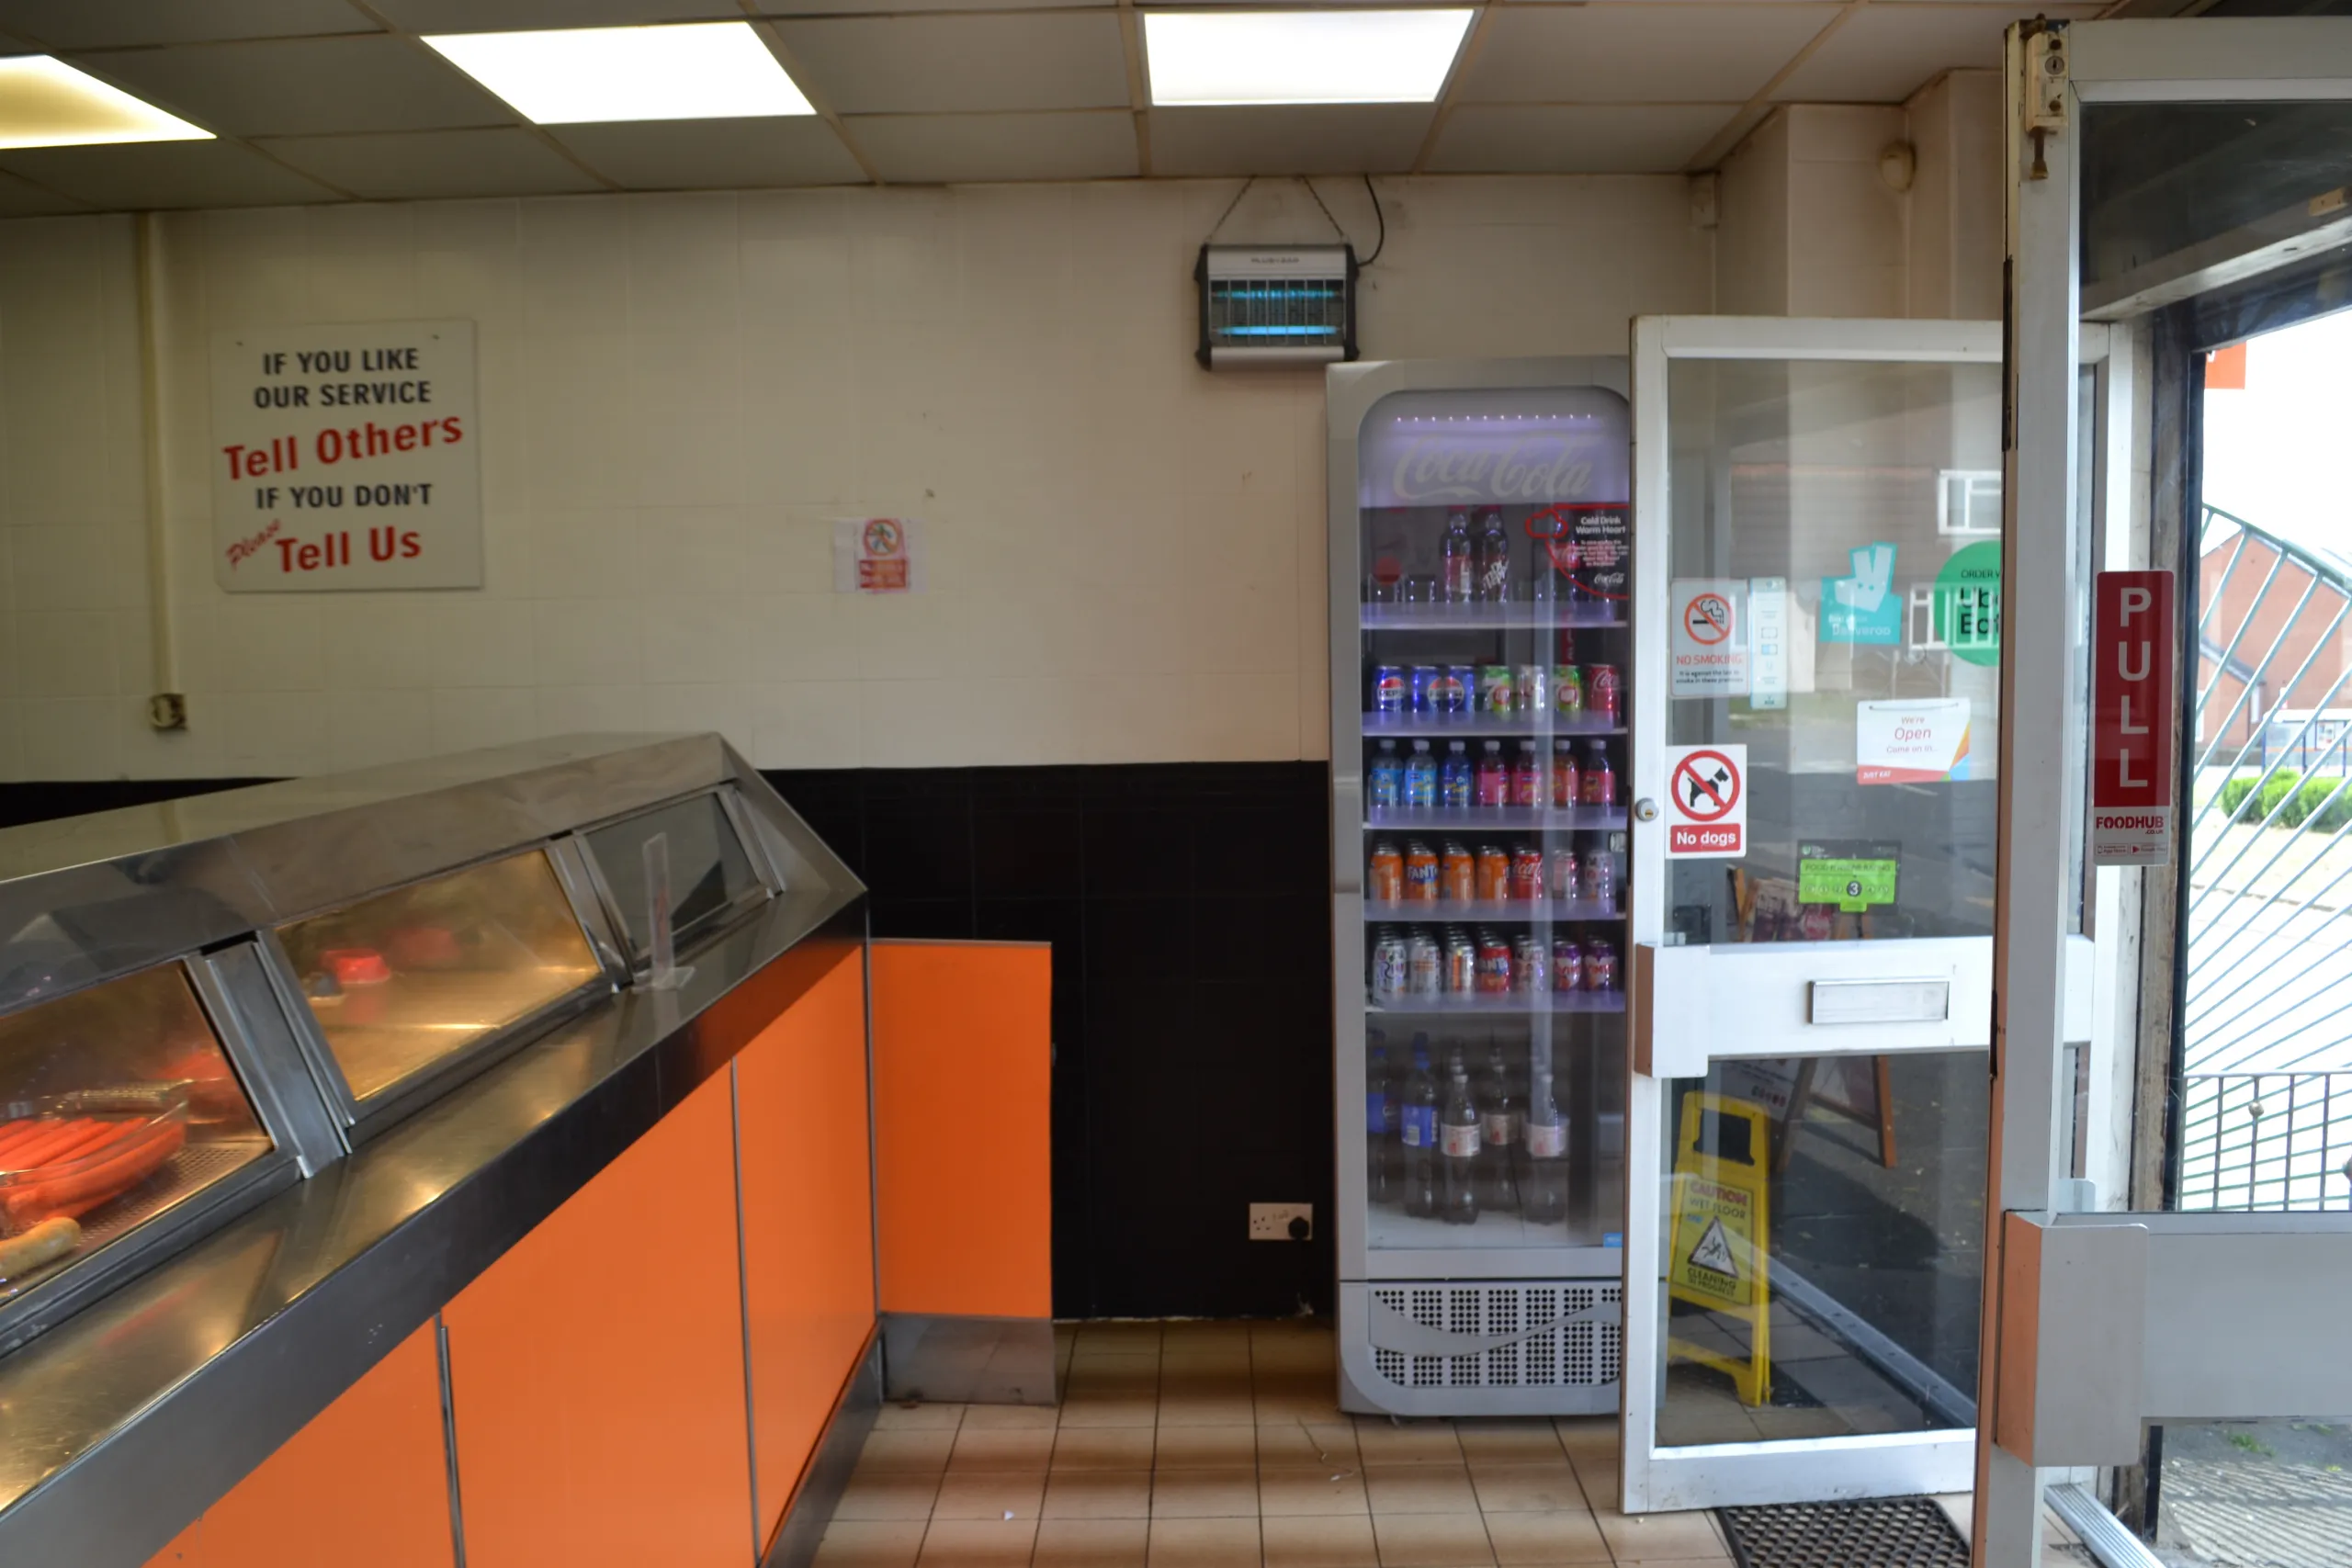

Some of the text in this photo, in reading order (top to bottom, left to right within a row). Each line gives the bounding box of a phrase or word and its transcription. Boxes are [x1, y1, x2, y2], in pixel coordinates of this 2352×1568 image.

[264, 347, 420, 375] IF YOU LIKE
[254, 380, 432, 409] OUR SERVICE
[221, 416, 464, 480] Tell Others
[256, 483, 434, 509] IF YOU DON'T
[1580, 515, 1622, 525] Cold Drink
[1576, 525, 1626, 535] Warm Heart
[275, 525, 422, 573] Tell Us
[1961, 569, 1994, 579] ORDER
[1677, 653, 1742, 665] NO SMOKING
[2119, 587, 2152, 787] PULL
[1901, 716, 1926, 725] We're
[1894, 727, 1932, 742] Open
[1886, 744, 1910, 754] Come
[1912, 744, 1923, 753] on
[1862, 770, 1892, 780] JUST EAT
[2096, 816, 2165, 829] FOODHUB
[1677, 830, 1736, 847] No dogs
[1849, 883, 1860, 896] 3
[1690, 1180, 1747, 1206] CAUTION
[1690, 1196, 1710, 1209] WET
[1713, 1202, 1747, 1220] FLOOR
[1688, 1268, 1736, 1290] CLEANING
